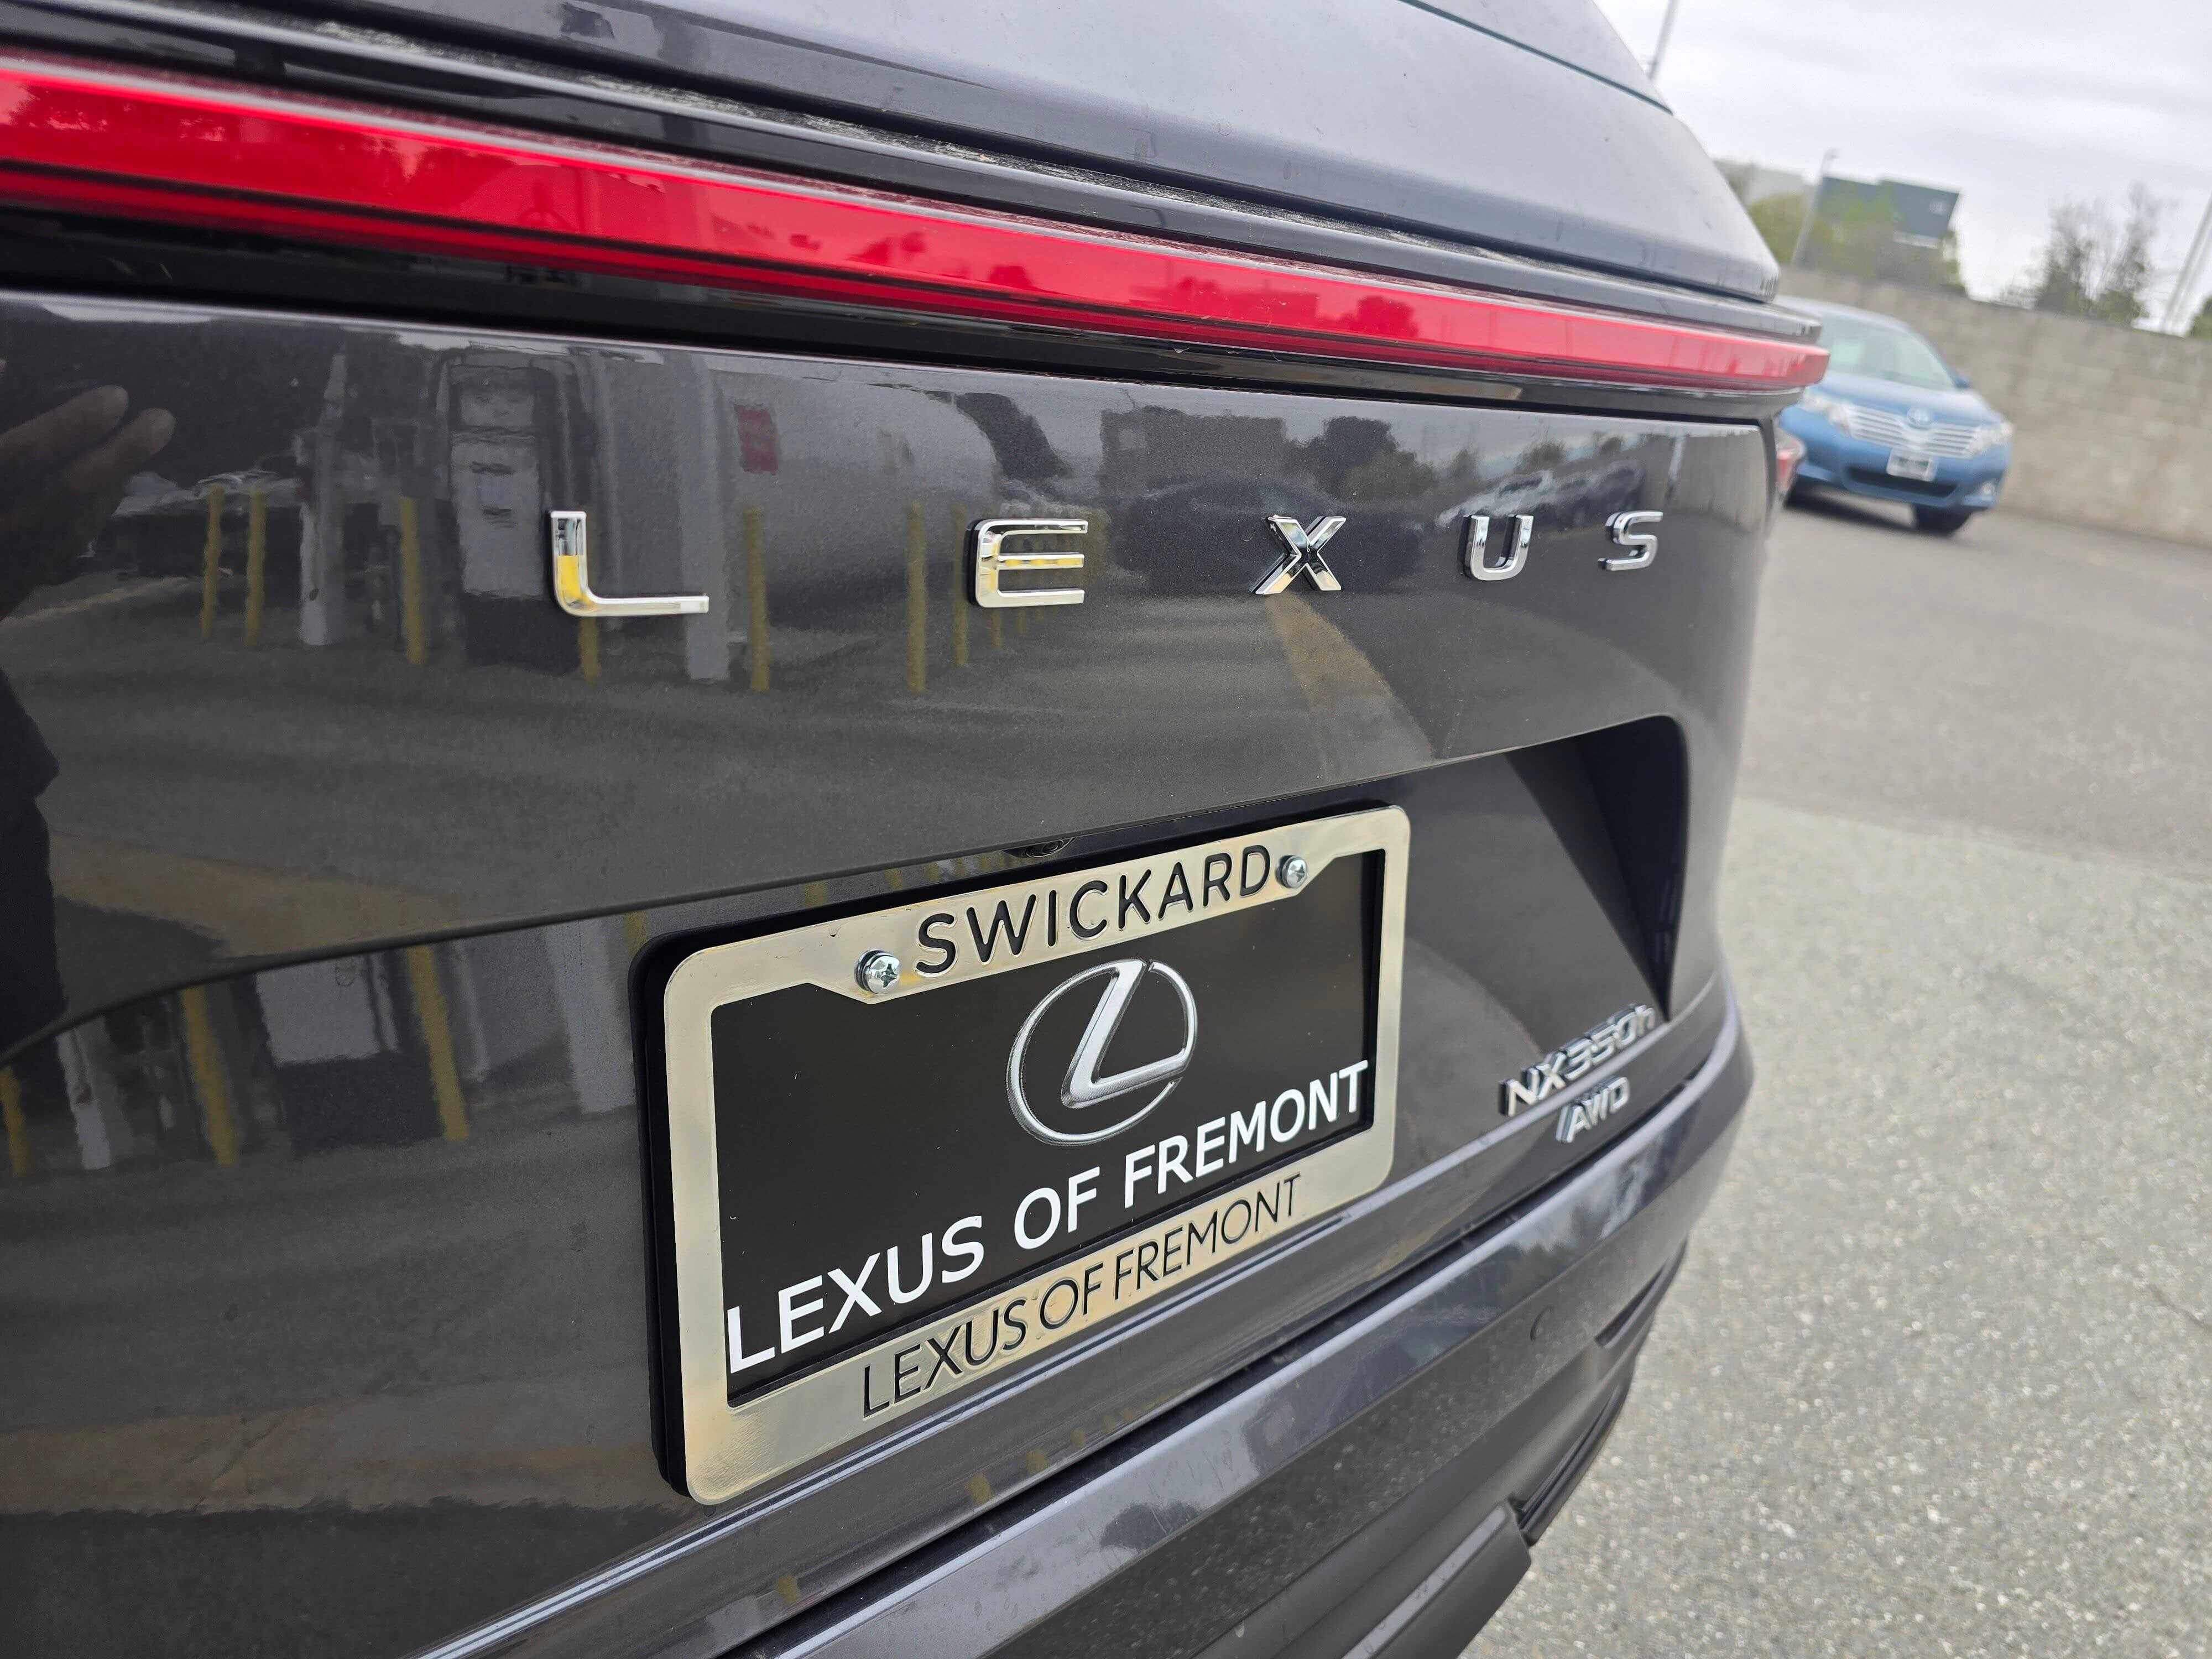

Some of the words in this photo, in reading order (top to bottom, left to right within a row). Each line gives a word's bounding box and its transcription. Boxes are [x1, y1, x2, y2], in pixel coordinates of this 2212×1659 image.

[549, 511, 1663, 616] LEXUS
[916, 844, 1271, 978] SWICKARD
[1556, 1076, 1630, 1143] AWD
[727, 1215, 985, 1374] LEXUS
[1014, 1166, 1100, 1250] OF
[1124, 1060, 1369, 1208] FREMONT
[863, 1298, 1029, 1420] LEXUS
[1039, 1265, 1103, 1330] OF
[1114, 1173, 1301, 1302] FREMONT
